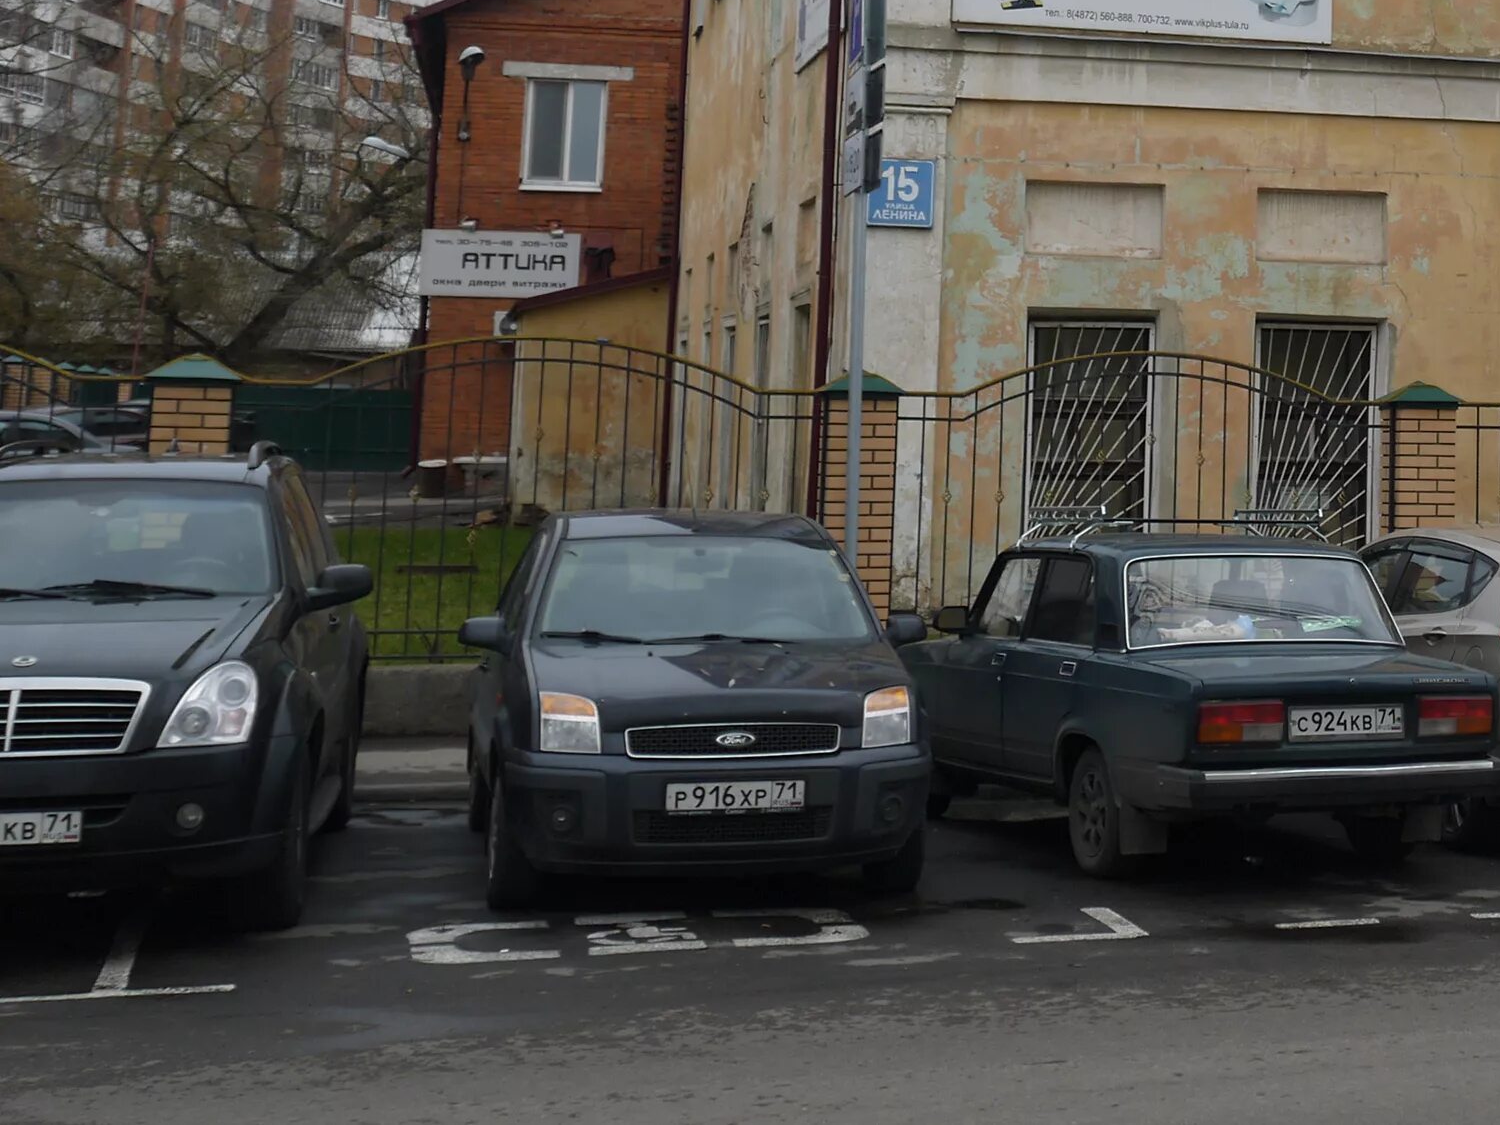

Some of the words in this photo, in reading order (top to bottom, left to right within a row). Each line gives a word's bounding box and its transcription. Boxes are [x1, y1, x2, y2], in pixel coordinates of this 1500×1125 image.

[1045, 9, 1064, 18] тел.:
[1066, 9, 1098, 21] 8(4872)
[1174, 18, 1249, 30] www.vikplus-tula.ru
[882, 166, 919, 202] 15
[872, 209, 926, 221] ЛЕНИНА
[885, 202, 915, 211] УЛИЦА
[461, 252, 566, 272] АТТИКА
[432, 278, 462, 287] окна
[468, 280, 506, 289] двери
[512, 281, 567, 290] витражи
[1296, 711, 1373, 733] С924КВ
[1377, 709, 1396, 725] 71
[673, 785, 768, 810] Р916ХР
[774, 782, 797, 800] 71
[46, 813, 73, 833] 71
